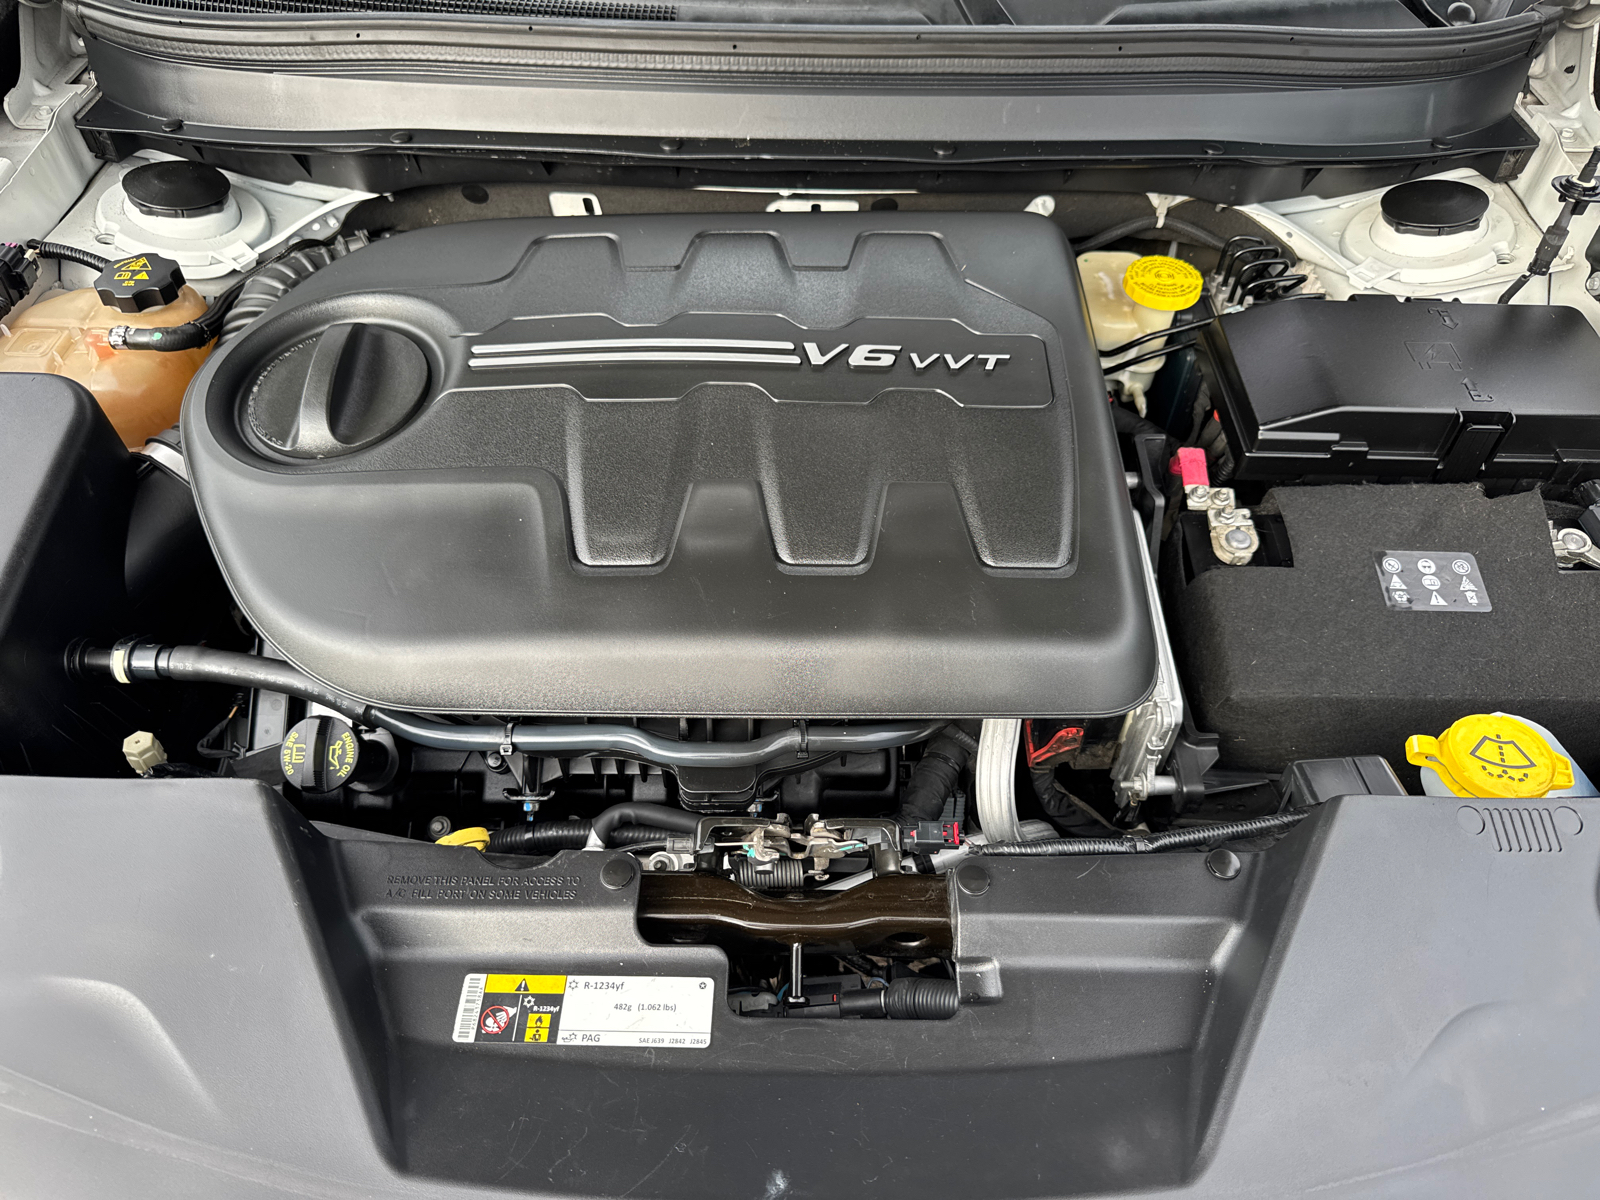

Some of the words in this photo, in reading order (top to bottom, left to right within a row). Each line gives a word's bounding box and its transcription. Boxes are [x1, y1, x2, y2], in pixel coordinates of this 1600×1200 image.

[803, 342, 902, 368] V6
[909, 353, 1011, 371] VVT
[285, 731, 299, 748] SAE
[341, 731, 354, 763] ENGINE
[283, 749, 294, 776] 5W-20
[336, 764, 351, 777] OIL
[386, 875, 431, 886] REMOVE
[434, 875, 458, 886] THIS
[460, 875, 494, 886] PANEL
[498, 875, 520, 886] FOR
[521, 875, 564, 886] ACCESS
[567, 875, 581, 886] TO
[385, 889, 406, 900] A/C
[411, 889, 433, 900] FILL
[437, 889, 466, 900] PORT
[469, 889, 486, 900] ON
[488, 889, 521, 900] SOME
[525, 889, 577, 900] VEHICLES
[584, 981, 625, 992] R-1234yf
[532, 1005, 560, 1013] R-1234yf
[614, 1003, 632, 1012] 482g
[637, 1003, 661, 1012] (1.062
[662, 1003, 677, 1012] lbs)
[581, 1033, 601, 1043] PAG
[651, 1037, 665, 1045] J639
